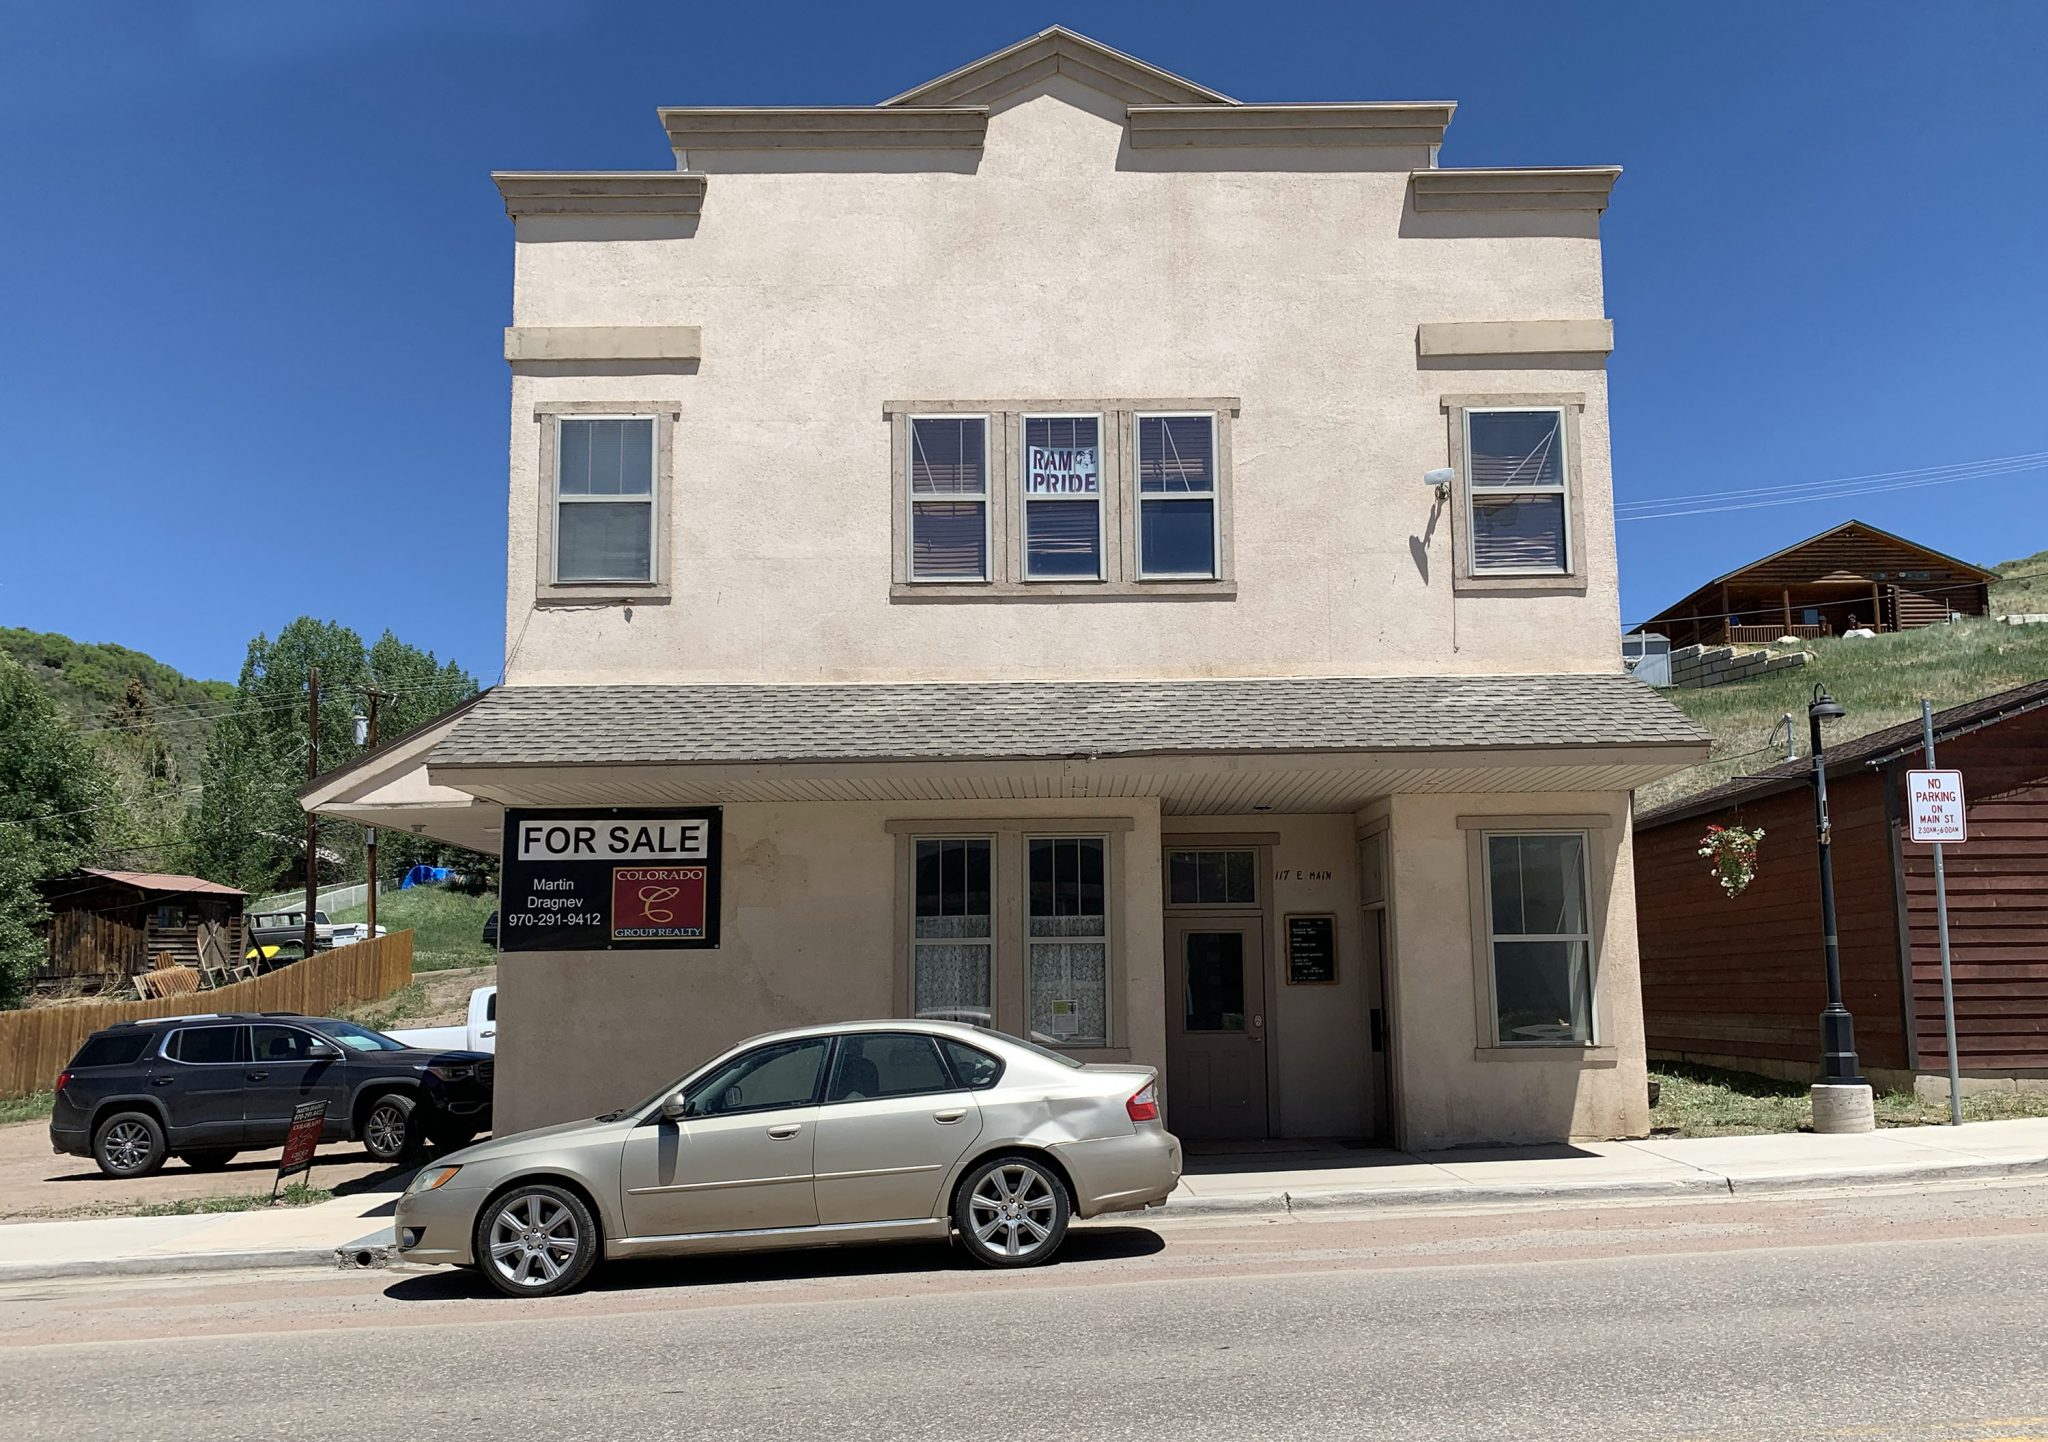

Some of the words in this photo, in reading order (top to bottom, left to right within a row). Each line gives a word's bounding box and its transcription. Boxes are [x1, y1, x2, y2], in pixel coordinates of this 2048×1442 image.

[1033, 472, 1097, 493] PRIDE
[1927, 778, 1941, 789] NO
[1916, 791, 1956, 802] PARKING
[1931, 804, 1943, 814] ON
[1920, 814, 1940, 824] MAIN
[524, 826, 597, 854] FOR
[607, 825, 700, 853] SALE
[616, 870, 703, 881] COLORADO
[1275, 869, 1290, 881] 117
[1296, 870, 1303, 880] E
[1309, 870, 1332, 881] MAIN
[533, 878, 574, 891] Martin
[527, 896, 584, 910] Dragnev
[508, 913, 601, 926] 970-291-9412
[614, 928, 656, 937] GROUP
[657, 927, 702, 936] REALTY
